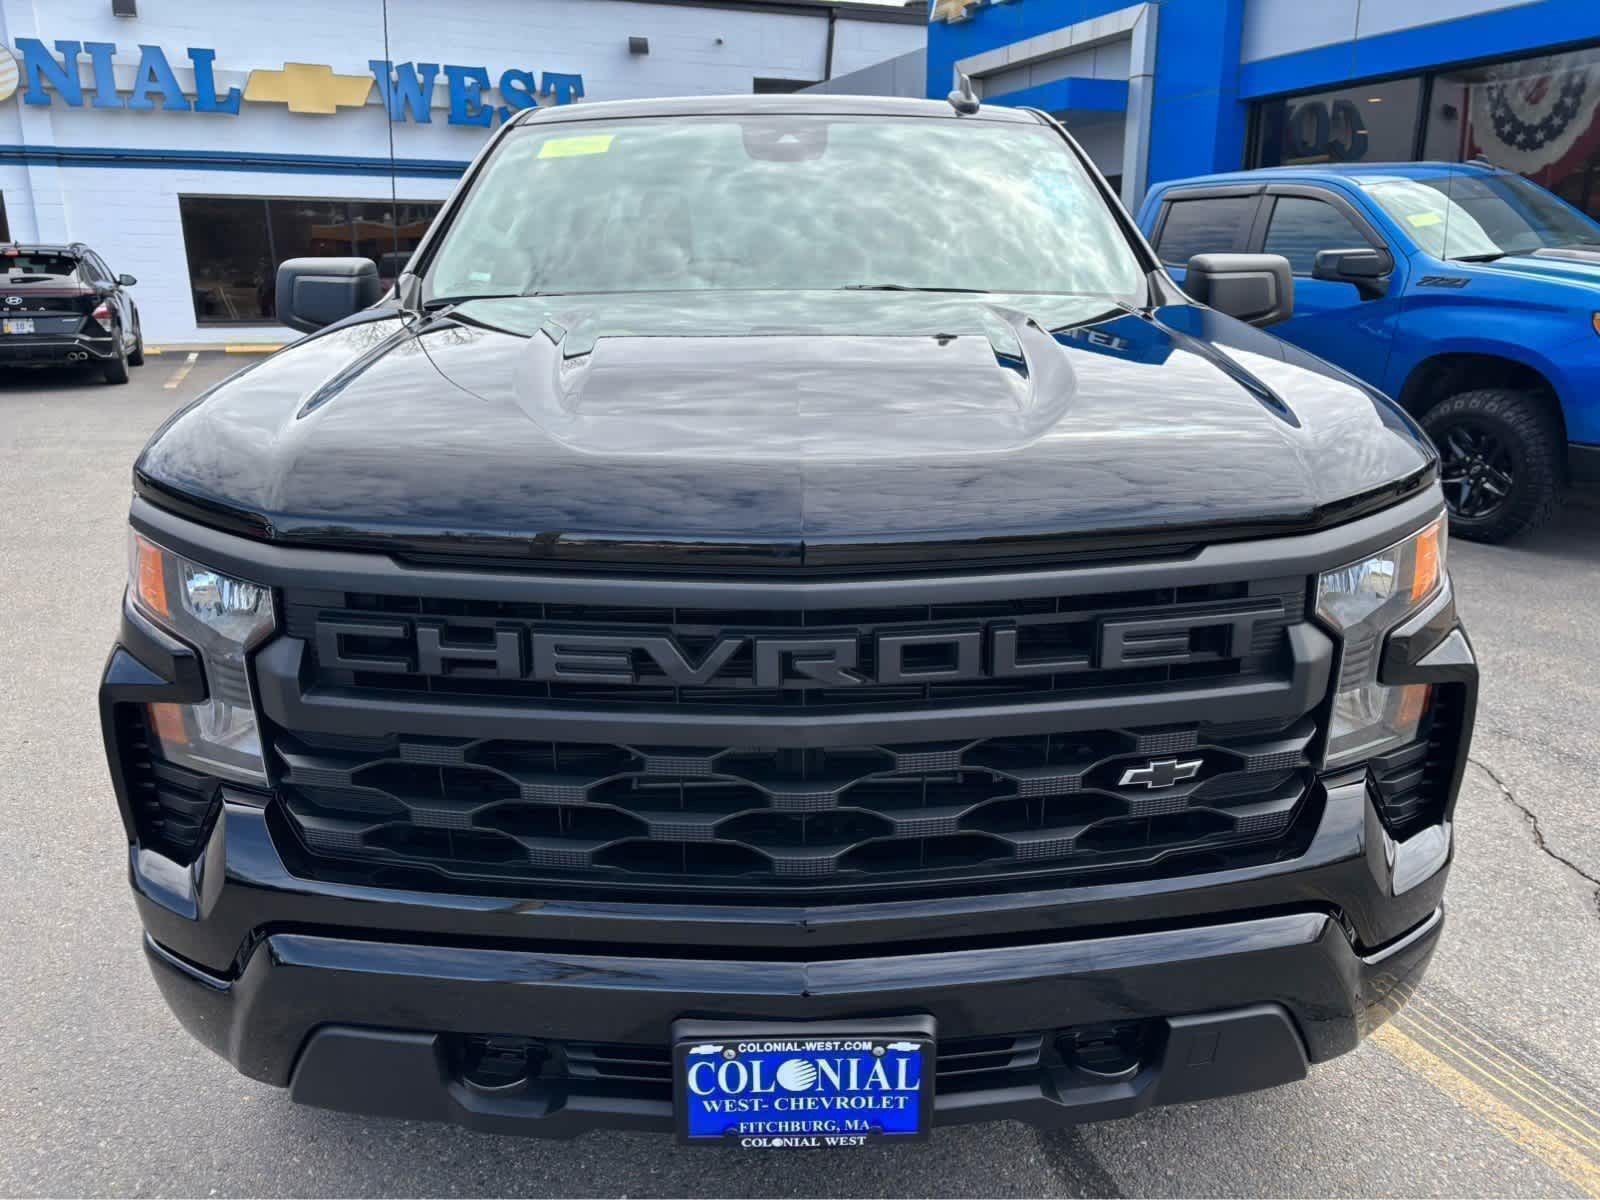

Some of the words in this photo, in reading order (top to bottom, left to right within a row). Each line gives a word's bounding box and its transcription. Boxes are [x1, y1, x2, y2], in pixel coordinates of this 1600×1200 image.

[368, 59, 585, 128] WEST
[315, 602, 1285, 687] CHEVROLET
[737, 1041, 873, 1053] COLONIAL-WEST.COM
[687, 1057, 921, 1095] COLONIAL
[773, 1096, 909, 1111] CHEVROLET
[739, 1120, 841, 1134] FITCHBURG,
[845, 1119, 871, 1131] MA
[824, 1136, 868, 1147] WEST
